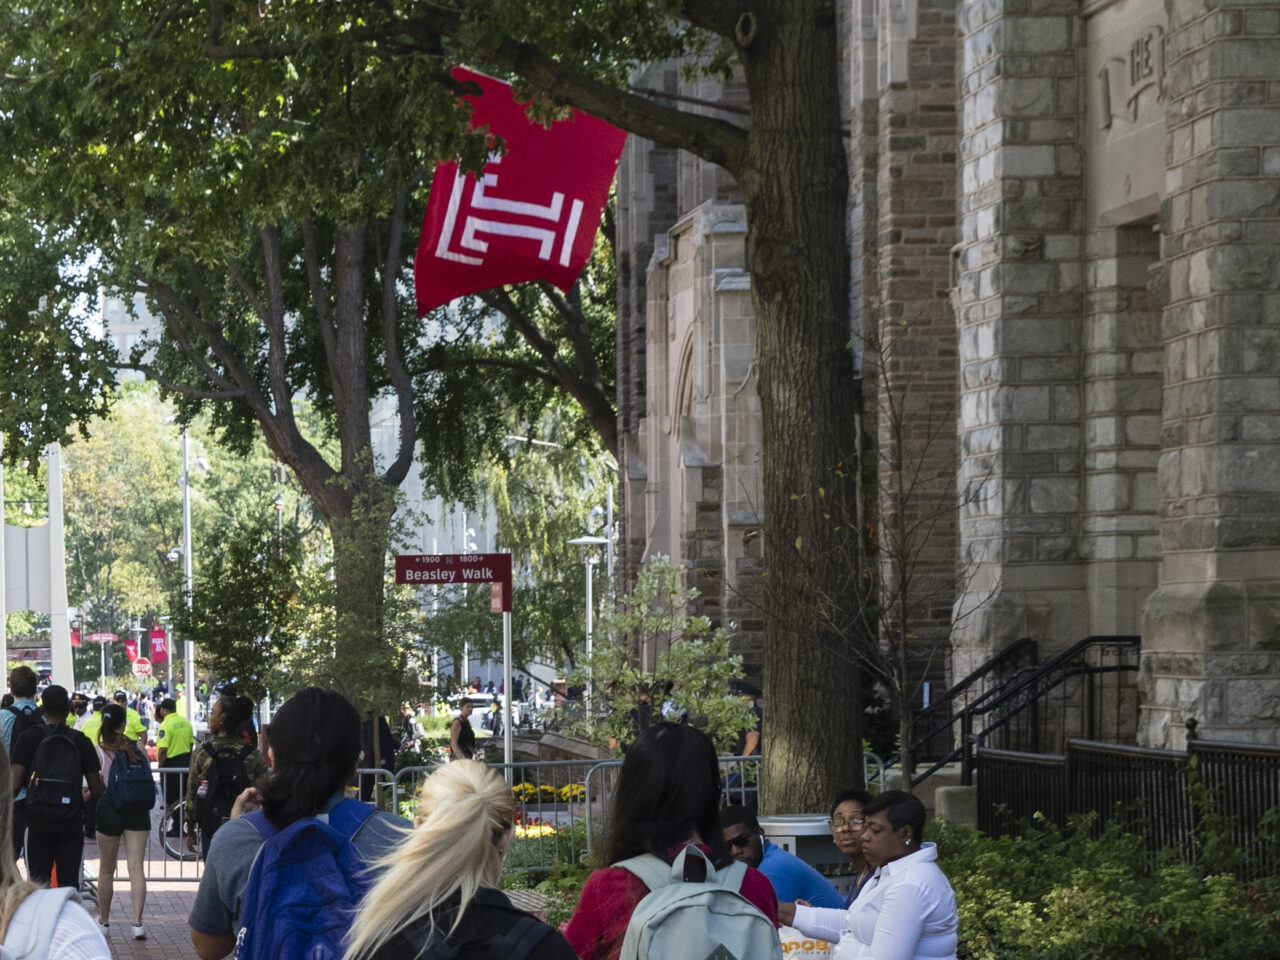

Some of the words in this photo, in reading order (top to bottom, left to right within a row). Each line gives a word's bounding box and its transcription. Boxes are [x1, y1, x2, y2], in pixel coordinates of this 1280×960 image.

[422, 555, 441, 563] 1900
[445, 557, 454, 565] N
[405, 569, 456, 582] Beasley
[462, 567, 493, 579] Walk
[151, 638, 164, 653] T
[134, 663, 151, 673] STOP
